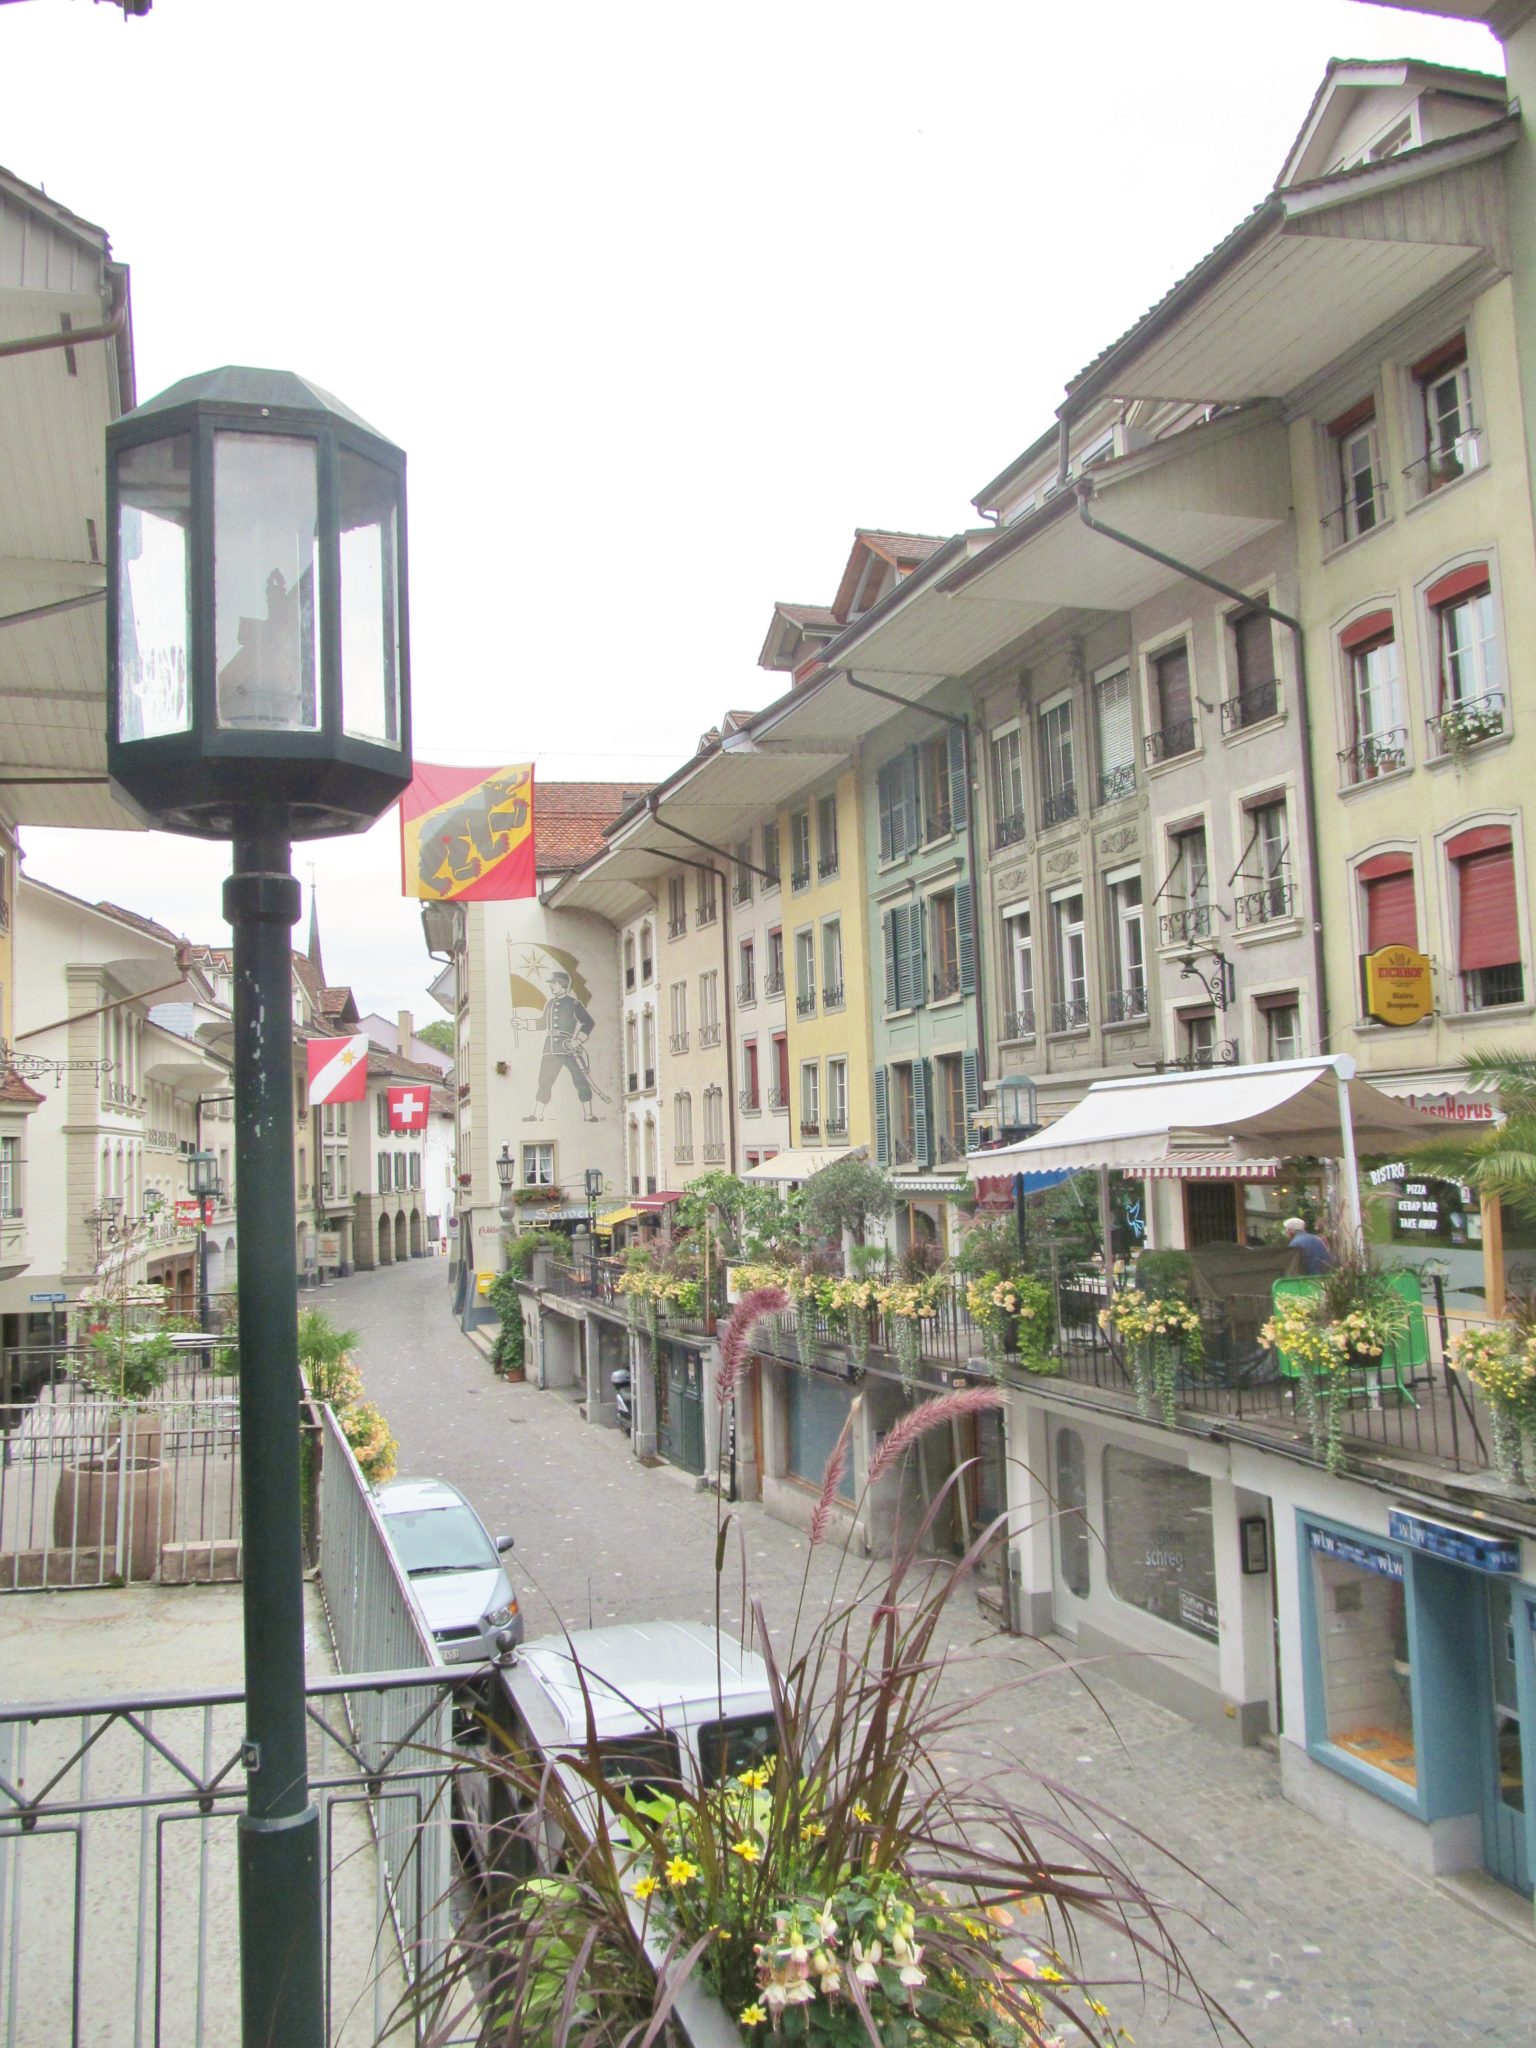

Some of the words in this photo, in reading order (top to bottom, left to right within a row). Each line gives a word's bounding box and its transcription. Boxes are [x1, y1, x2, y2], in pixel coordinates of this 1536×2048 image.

[1378, 967, 1424, 979] EICHHOF
[1370, 1162, 1405, 1185] BISTRO
[1406, 1184, 1427, 1195] PIZZA
[1399, 1201, 1420, 1211] KEBAP
[1423, 1202, 1438, 1212] BAR
[1400, 1218, 1417, 1228] TAKE
[1419, 1219, 1437, 1229] AWAY
